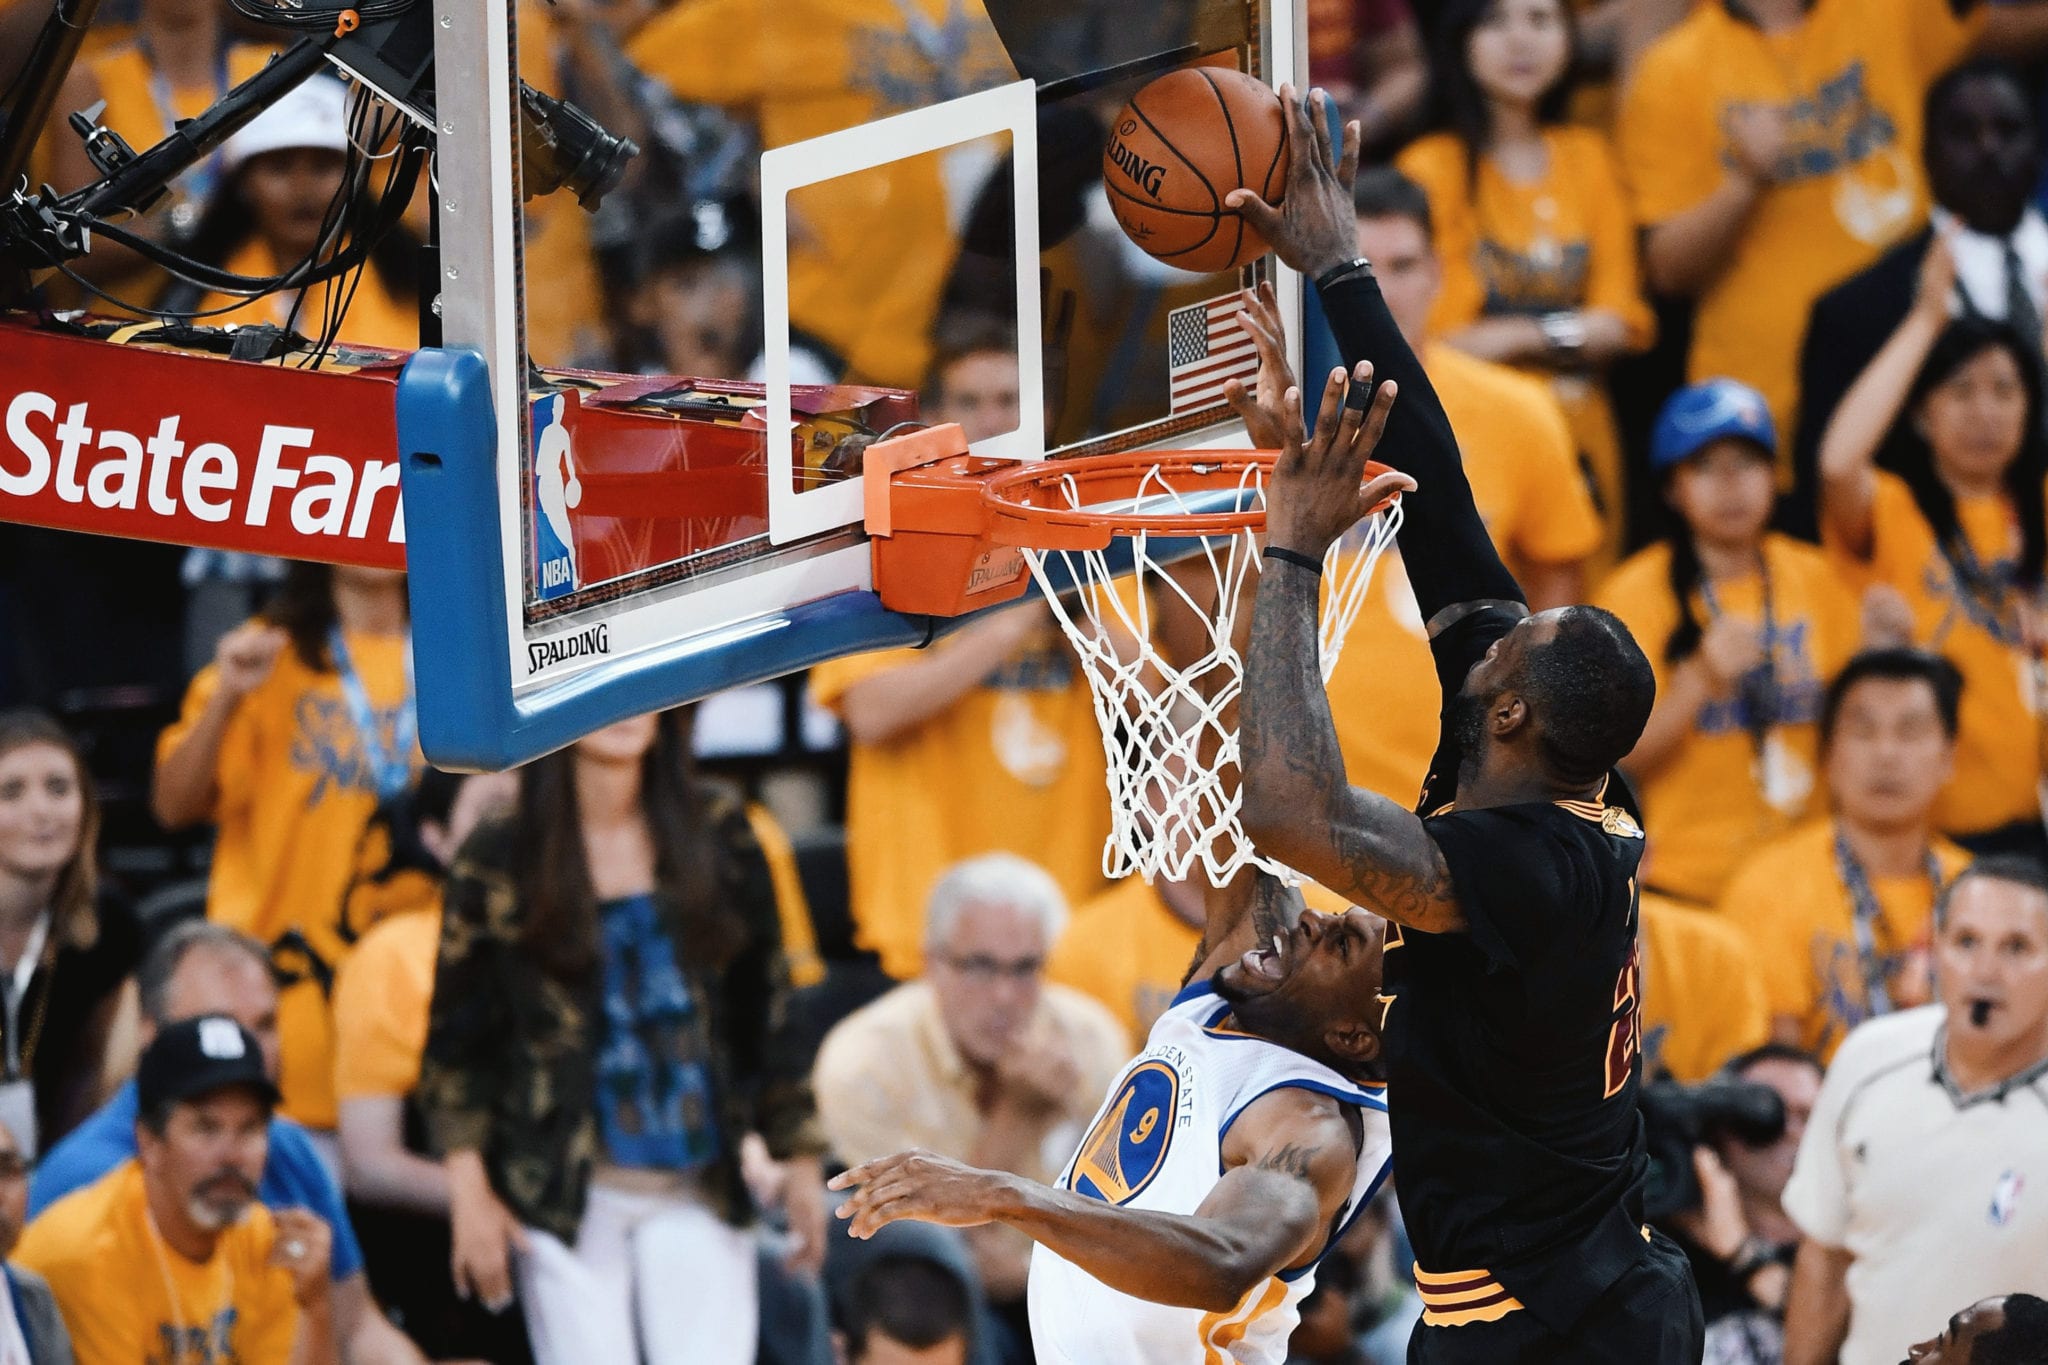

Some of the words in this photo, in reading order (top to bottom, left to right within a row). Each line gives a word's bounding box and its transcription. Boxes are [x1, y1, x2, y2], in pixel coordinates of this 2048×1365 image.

[0, 391, 239, 522] State
[245, 424, 406, 543] Far
[542, 556, 571, 589] NBA
[528, 622, 608, 675] SPALDING
[1179, 1066, 1194, 1128] STATE
[1129, 1106, 1160, 1145] 9
